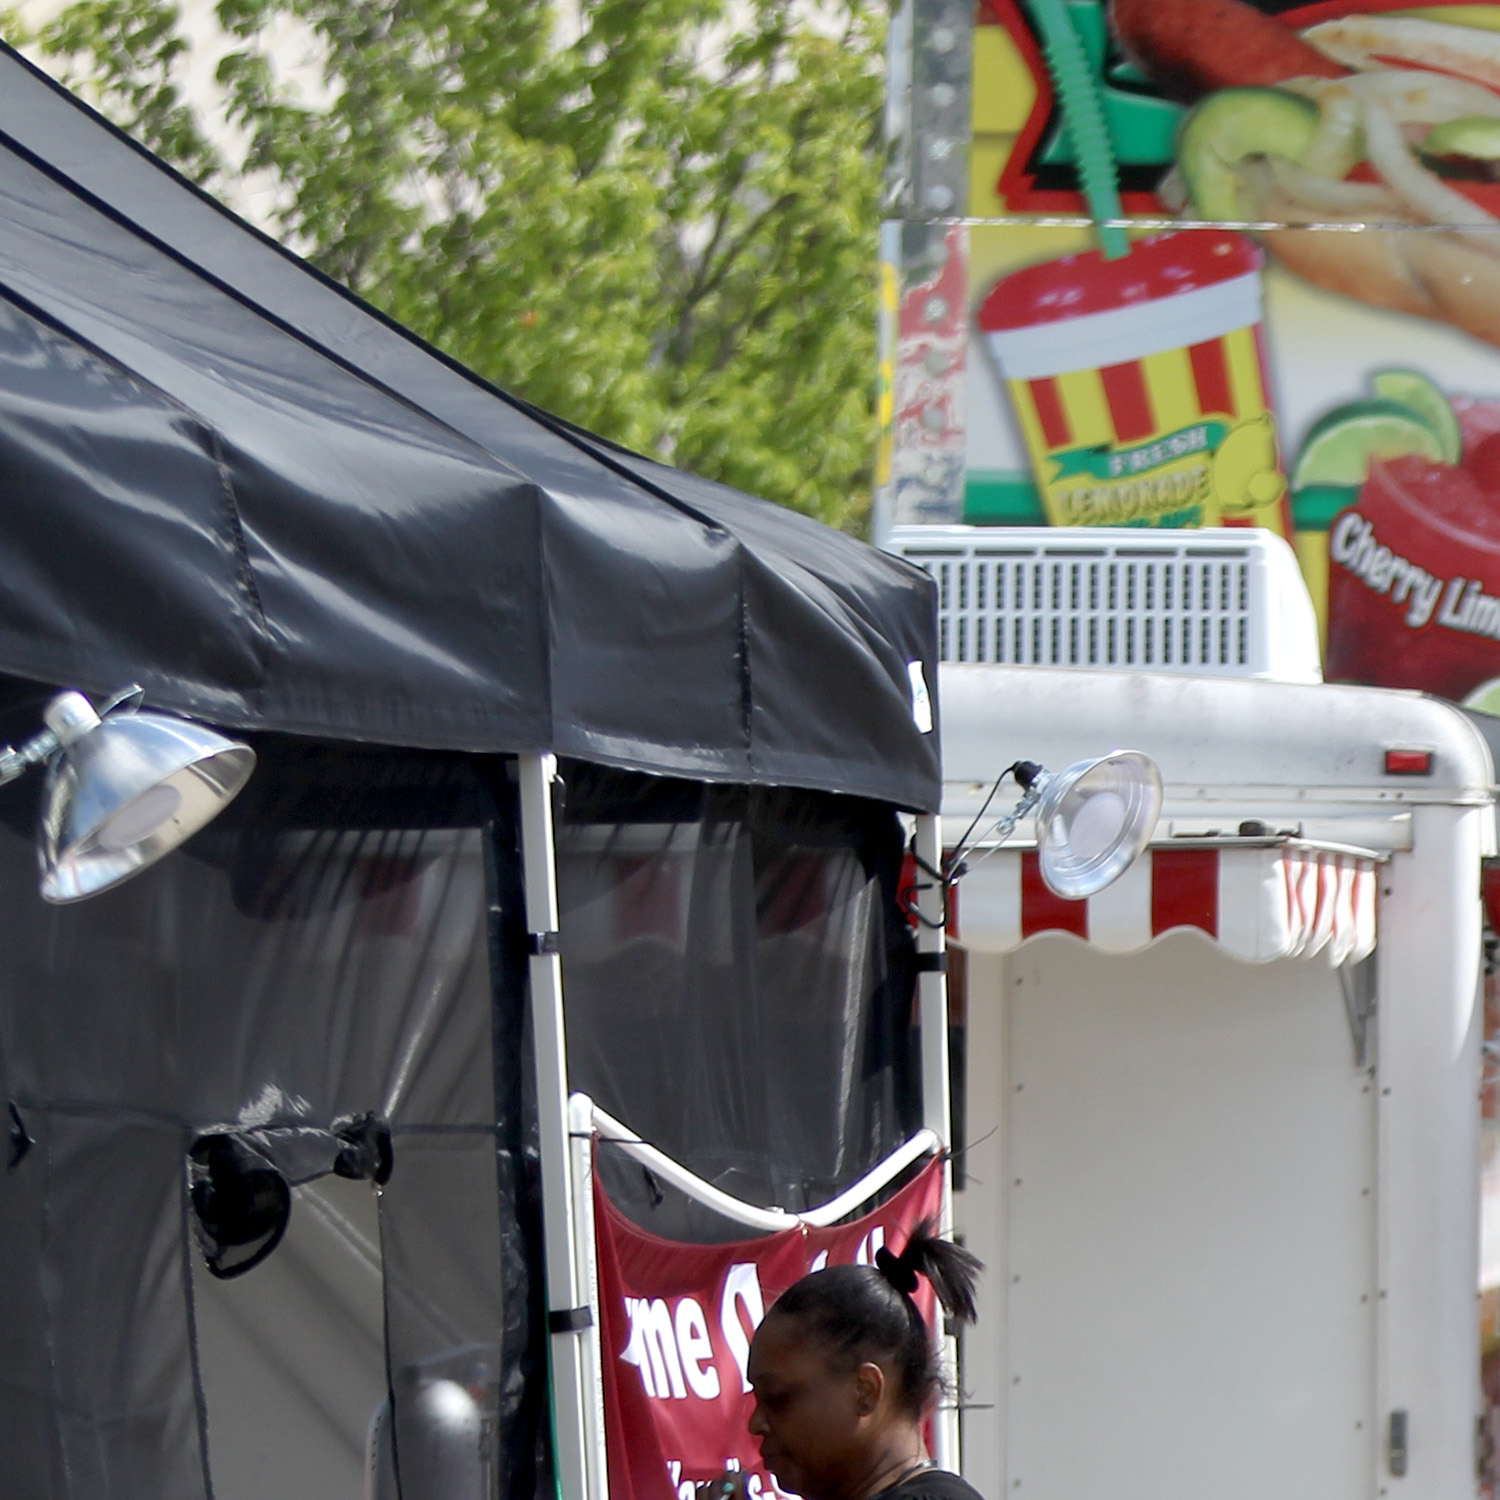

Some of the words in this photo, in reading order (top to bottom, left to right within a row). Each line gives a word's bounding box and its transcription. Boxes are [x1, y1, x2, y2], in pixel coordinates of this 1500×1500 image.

[1108, 424, 1208, 478] FRESH
[1058, 464, 1212, 521] LEMONADE
[1331, 511, 1444, 629] Cherry
